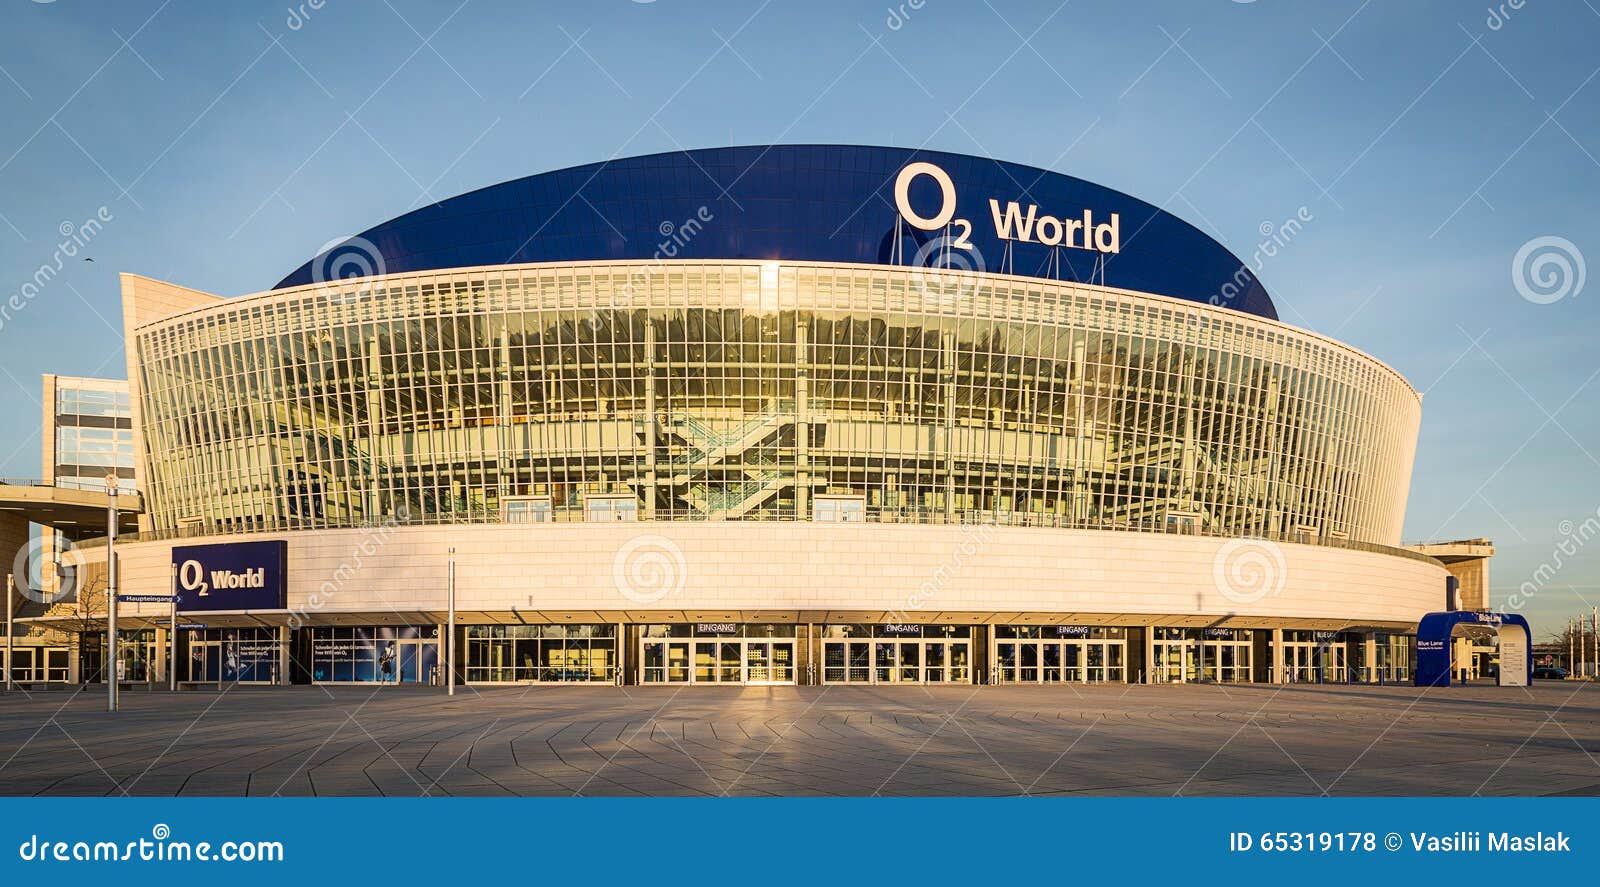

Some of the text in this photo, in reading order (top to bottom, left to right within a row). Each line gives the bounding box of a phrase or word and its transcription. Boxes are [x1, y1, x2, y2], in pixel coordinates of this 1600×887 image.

[894, 161, 1120, 255] O2 World
[180, 559, 265, 597] O2 World
[125, 595, 173, 603] Haupteingang
[699, 622, 735, 633] EINGANG
[885, 624, 919, 633] EINGANG
[1058, 626, 1089, 635] EINGANG
[1204, 628, 1229, 637] EINGANG
